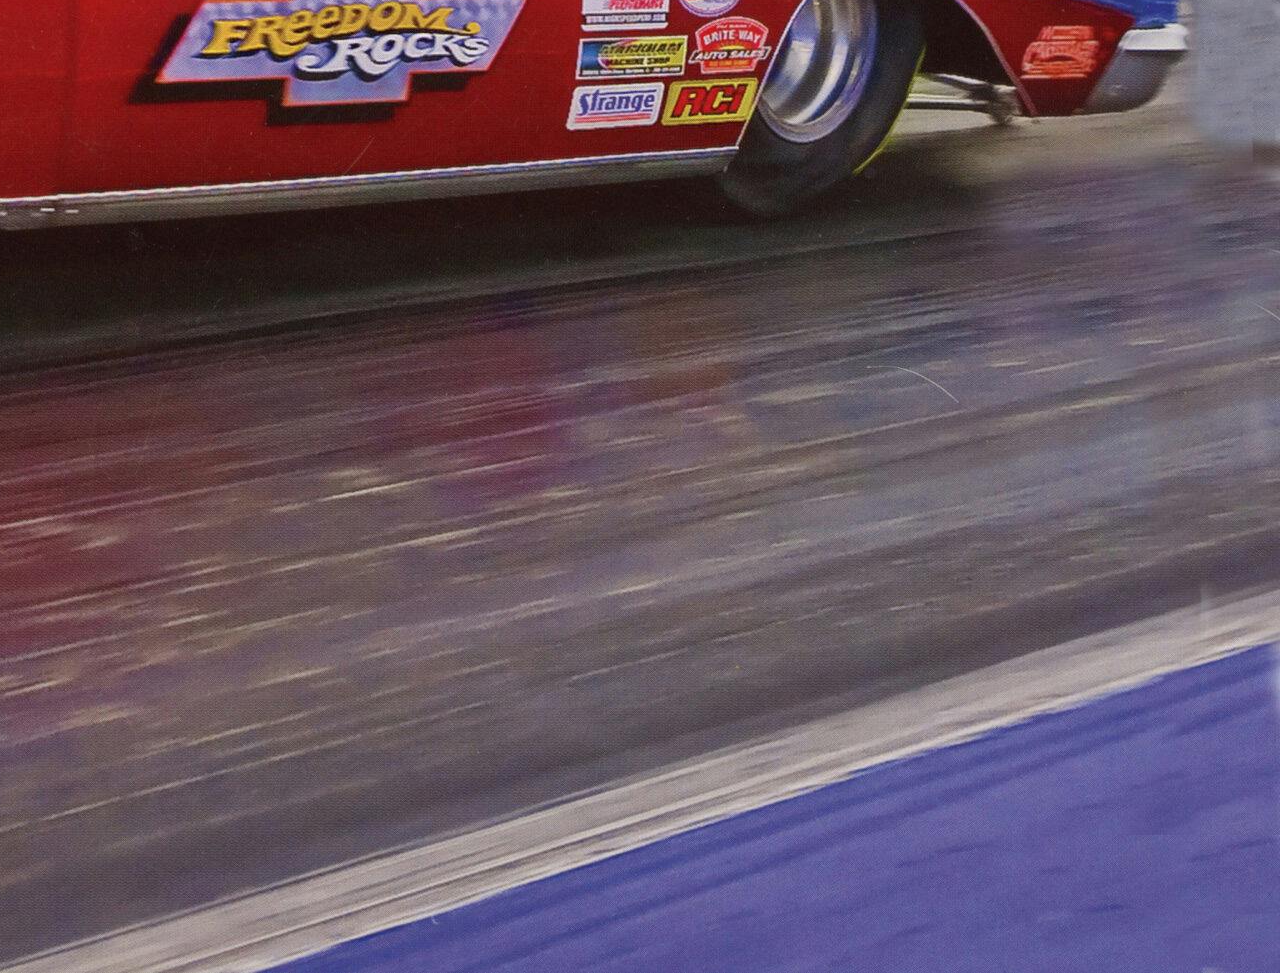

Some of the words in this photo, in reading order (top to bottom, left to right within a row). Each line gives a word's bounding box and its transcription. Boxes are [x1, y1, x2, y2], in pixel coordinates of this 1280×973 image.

[695, 51, 728, 60] AUTO
[578, 89, 656, 116] Strange
[671, 84, 748, 118] RCI
